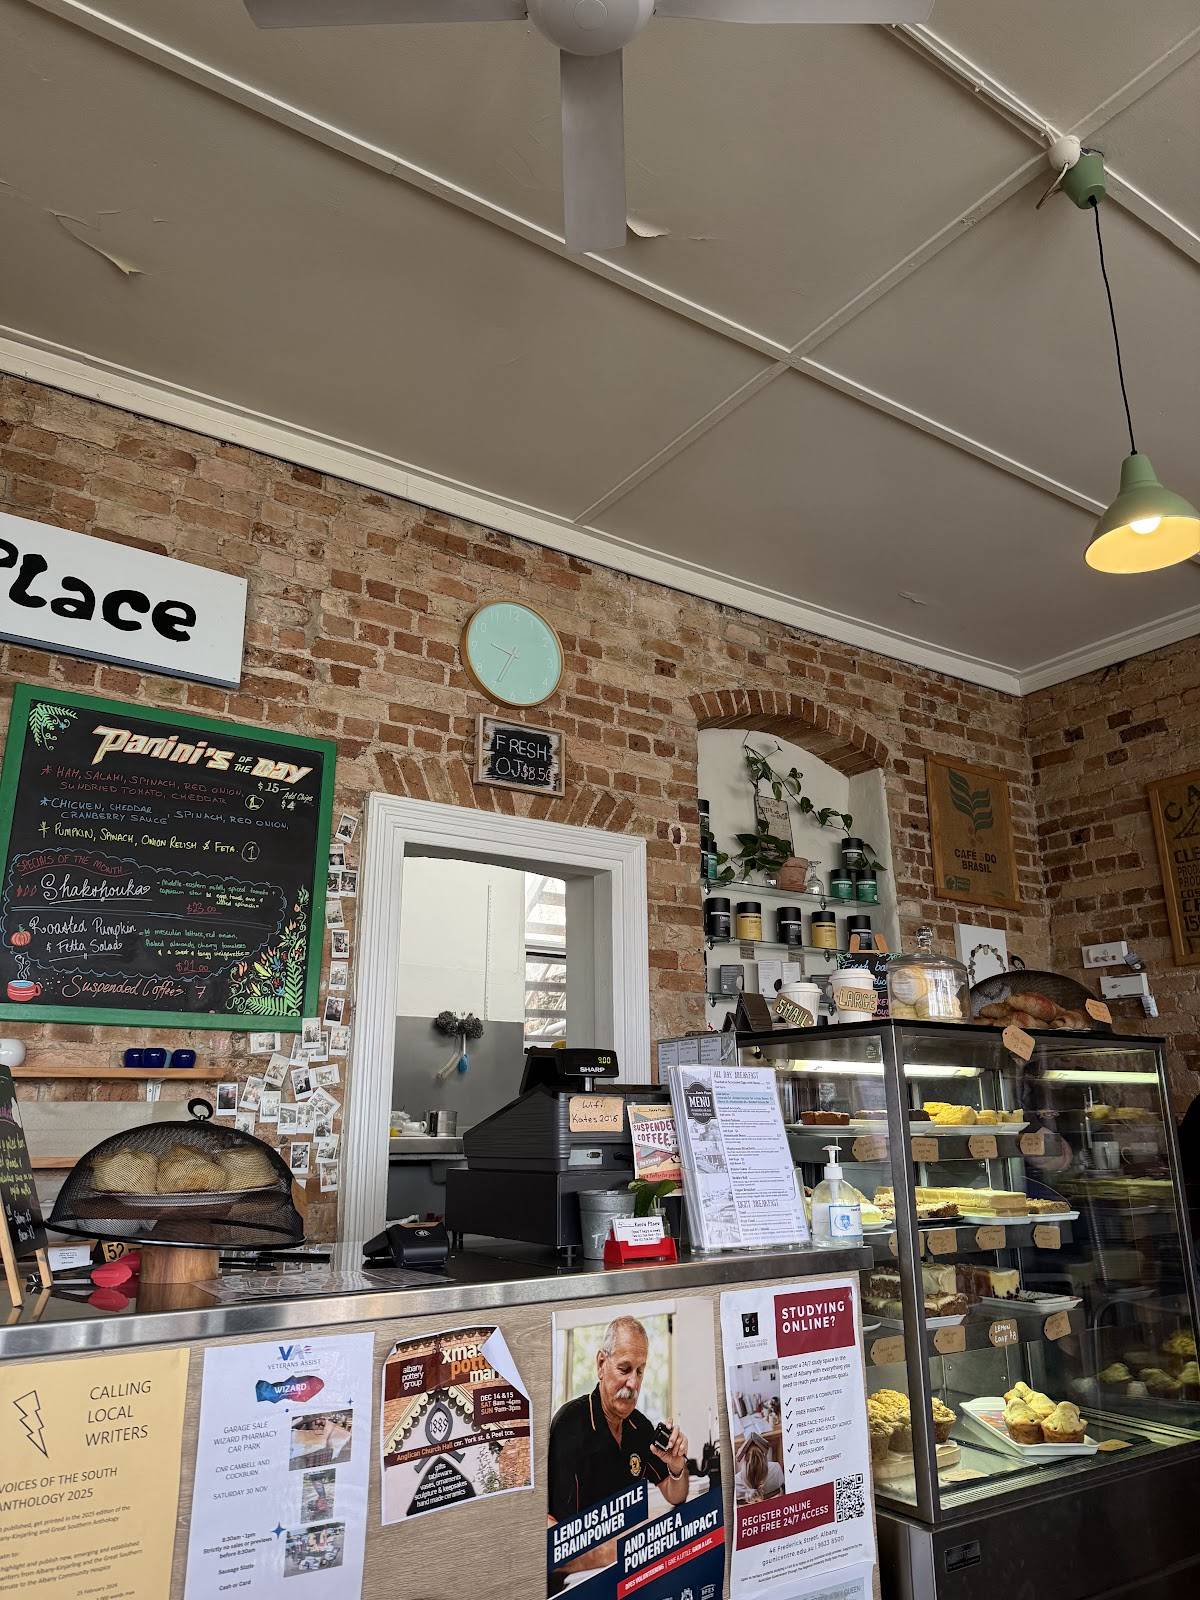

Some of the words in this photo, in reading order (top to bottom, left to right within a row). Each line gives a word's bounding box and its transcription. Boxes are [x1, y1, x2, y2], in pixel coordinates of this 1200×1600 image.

[91, 725, 235, 771] Panini's
[496, 735, 548, 762] FRESH
[238, 755, 253, 764] OF
[234, 763, 252, 774] THE
[56, 766, 82, 779] HAM,
[85, 770, 126, 783] SALAMI,
[128, 775, 179, 790] SPINACH,
[184, 782, 207, 792] RED
[212, 787, 244, 798] ONION,
[172, 793, 227, 805] CHEDDAR
[51, 797, 104, 811] CHICKEN,
[110, 803, 152, 814] CHEDDAR
[174, 811, 226, 823] SPINACH,
[230, 817, 252, 825] RED
[256, 820, 289, 830] ONION,
[60, 812, 125, 822] CRANBERRY
[130, 816, 168, 825] SAUCE
[16, 855, 54, 873] SPECIALS
[58, 855, 70, 864] OF
[74, 855, 89, 864] THE
[984, 853, 997, 864] DO
[961, 860, 992, 873] BRASIL
[41, 873, 151, 900] Shakshouka
[29, 916, 87, 935] Roasted
[92, 917, 137, 939] Pumpkin
[89, 939, 123, 953] Salad
[62, 975, 139, 998] Suspended
[838, 989, 877, 1011] LARGE
[776, 999, 809, 1028] SMALL
[688, 1096, 711, 1108] MENU
[637, 1132, 670, 1146] COFFEE
[107, 1243, 125, 1262] 52
[781, 1301, 845, 1320] STUDYING
[782, 1315, 836, 1334] ONLINE?
[267, 1361, 298, 1371] VETERANS
[402, 1364, 424, 1374] albany
[781, 1363, 798, 1371] Discover
[811, 1358, 822, 1367] study
[822, 1357, 835, 1365] space
[798, 1368, 812, 1377] Albany
[821, 1364, 843, 1373] everything
[401, 1372, 425, 1384] pottery
[469, 1368, 499, 1383] mar
[89, 1380, 152, 1401] CALLING
[274, 1383, 307, 1394] WIZARD
[403, 1379, 423, 1391] group
[480, 1394, 493, 1402] DEC
[480, 1401, 492, 1409] SAT
[87, 1405, 134, 1424] LOCAL
[806, 1405, 826, 1414] PRINTING
[224, 1424, 251, 1434] GARAGE
[252, 1420, 269, 1430] SALE
[796, 1428, 816, 1437] SUPPORT
[85, 1425, 148, 1447] WRITERS
[213, 1435, 240, 1446] WIZARD
[241, 1430, 278, 1442] PHARMACY
[228, 1445, 242, 1454] CAR
[243, 1442, 261, 1451] PARK
[396, 1450, 421, 1462] Anglican
[421, 1445, 442, 1456] Church
[442, 1442, 454, 1450] Hall
[464, 1435, 477, 1444] York
[491, 1430, 504, 1439] Peel
[798, 1446, 825, 1456] WORKSHOPS
[799, 1457, 825, 1468] WELCOMING
[40, 1476, 56, 1488] OF
[58, 1473, 79, 1485] THE
[81, 1467, 118, 1482] SOUTH
[428, 1469, 453, 1481] tableware
[799, 1466, 825, 1477] COMMUNITY
[435, 1474, 462, 1486] ornaments
[67, 1488, 94, 1501] 2025
[213, 1489, 245, 1500] SATURDAY
[246, 1487, 254, 1495] 30
[255, 1485, 269, 1493] NOV
[414, 1486, 438, 1501] sculpture
[444, 1489, 466, 1501] ceramics
[554, 1521, 583, 1545] LEND
[584, 1511, 599, 1531] US
[600, 1507, 611, 1524] A
[609, 1485, 644, 1519] LITTLE
[741, 1509, 781, 1527] REGISTER
[783, 1500, 811, 1516] ONLINE
[741, 1525, 759, 1539] FOR
[760, 1519, 782, 1533] FREE
[783, 1514, 799, 1528] 24/7
[800, 1504, 829, 1520] ACCESS
[553, 1512, 625, 1565] BRAINPOWER
[624, 1532, 646, 1557] AND
[646, 1516, 674, 1544] HAVE
[674, 1512, 683, 1529] A
[624, 1530, 680, 1574] POWERFUL
[680, 1509, 719, 1544] IMPACT
[777, 1541, 802, 1552] Frederick
[820, 1528, 839, 1538] Albany
